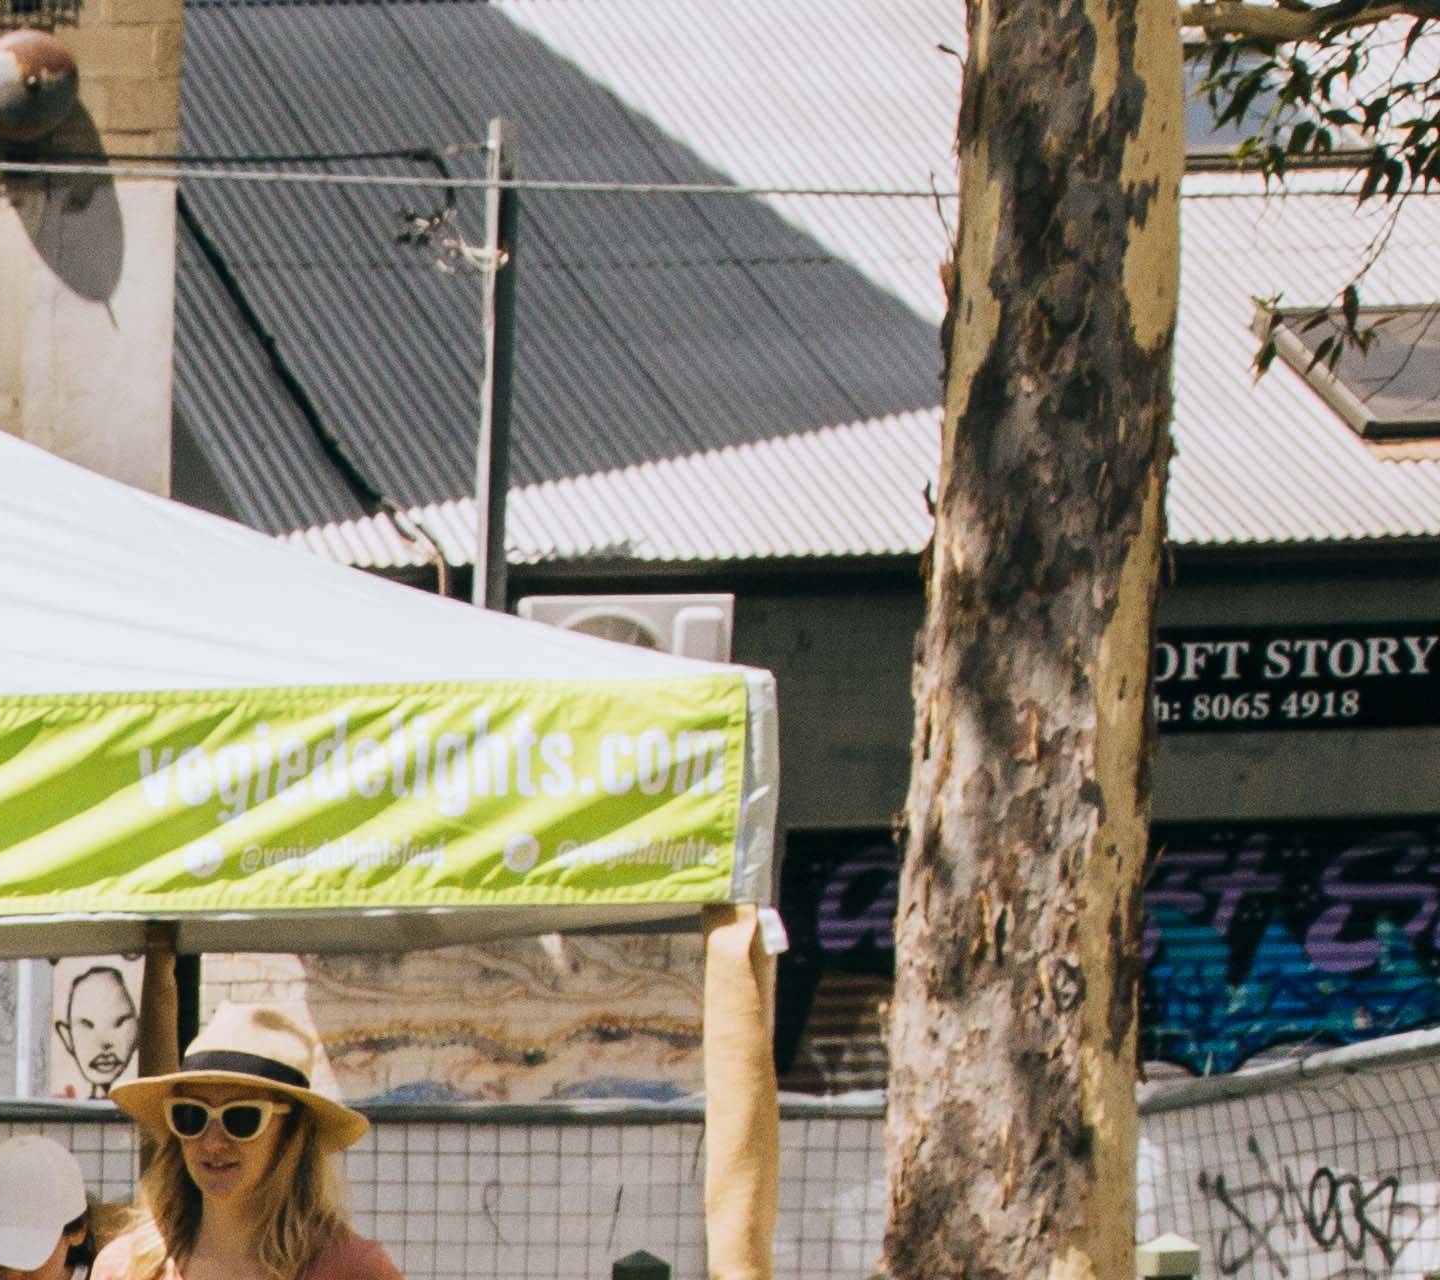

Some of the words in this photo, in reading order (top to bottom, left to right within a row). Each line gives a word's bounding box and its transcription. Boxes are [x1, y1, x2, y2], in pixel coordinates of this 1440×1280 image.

[1154, 641, 1249, 682] OFT
[1264, 636, 1439, 679] STORY
[1154, 698, 1181, 721] h:
[1192, 693, 1271, 721] 8065
[1280, 690, 1361, 719] 4918
[138, 713, 725, 825] vegiedelights.com
